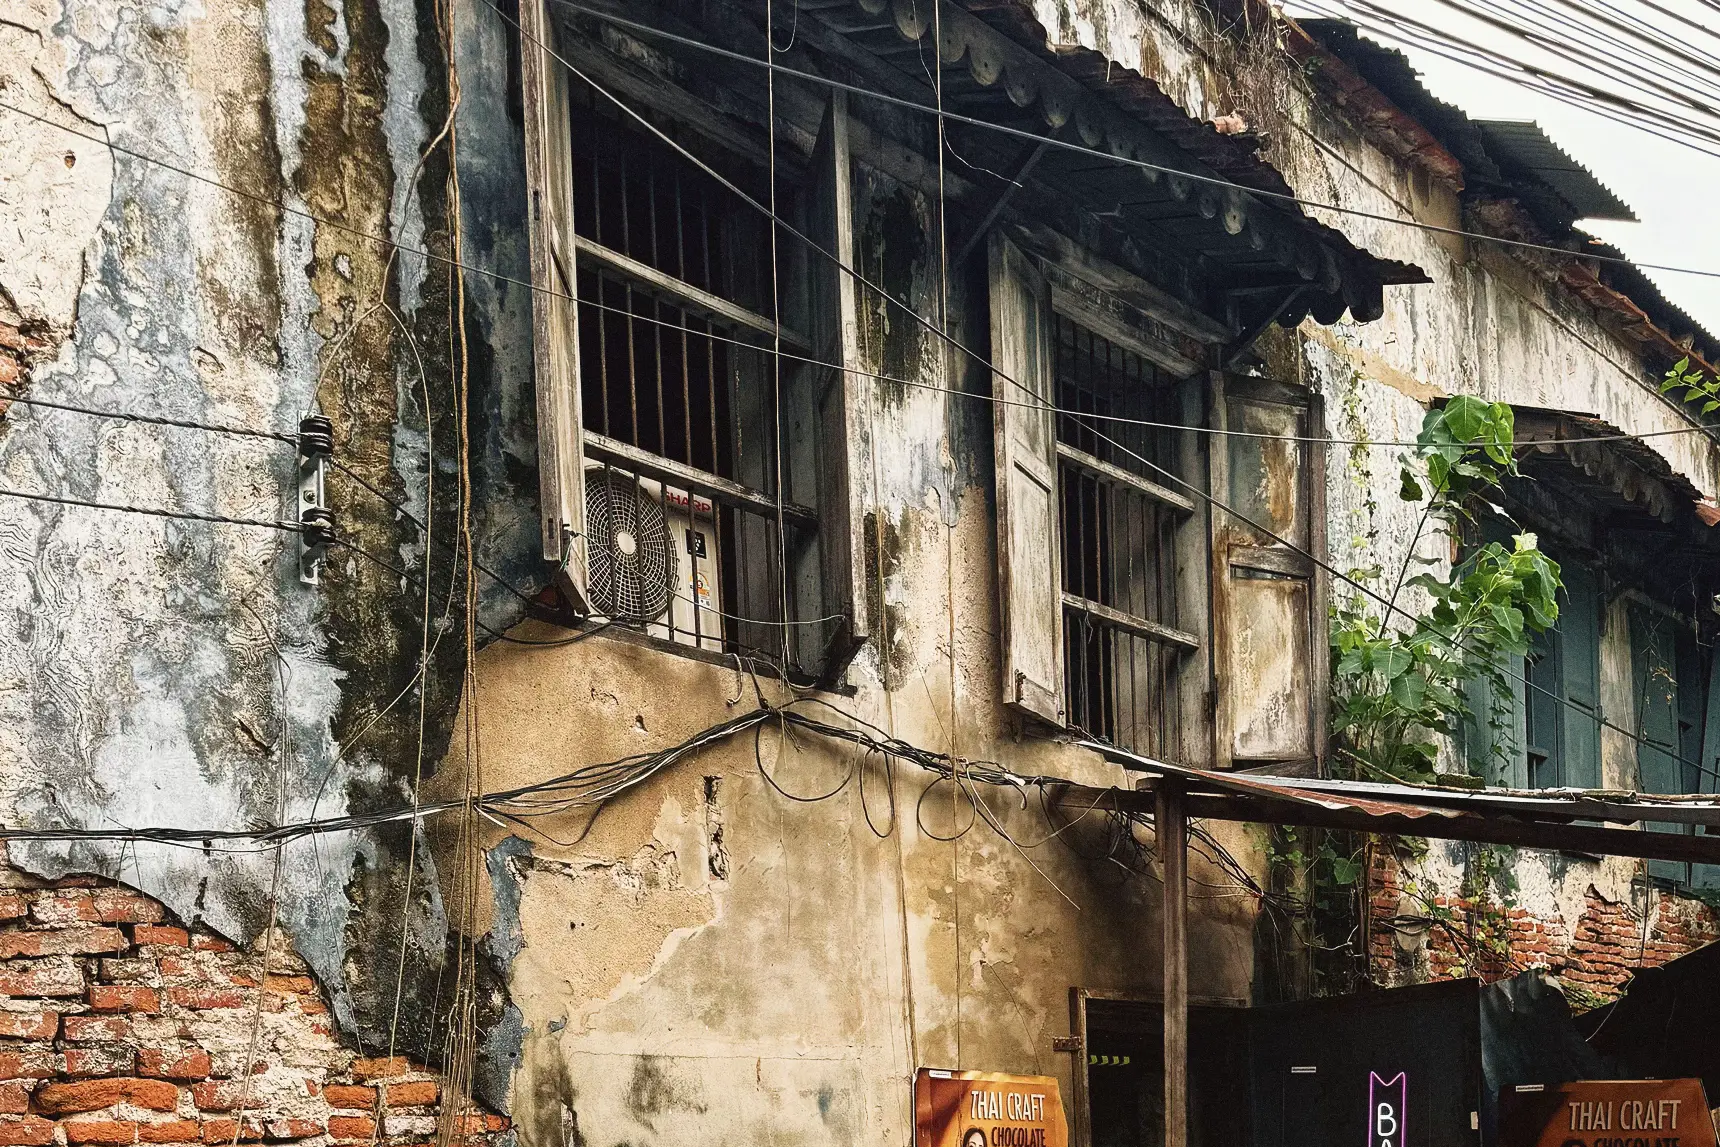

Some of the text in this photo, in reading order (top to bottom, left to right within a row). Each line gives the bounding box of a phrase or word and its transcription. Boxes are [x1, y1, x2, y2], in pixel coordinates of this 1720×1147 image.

[666, 491, 711, 512] SHARP
[971, 1091, 1045, 1122] THAI CRAFT
[1568, 1099, 1682, 1132] THAI CRAFT
